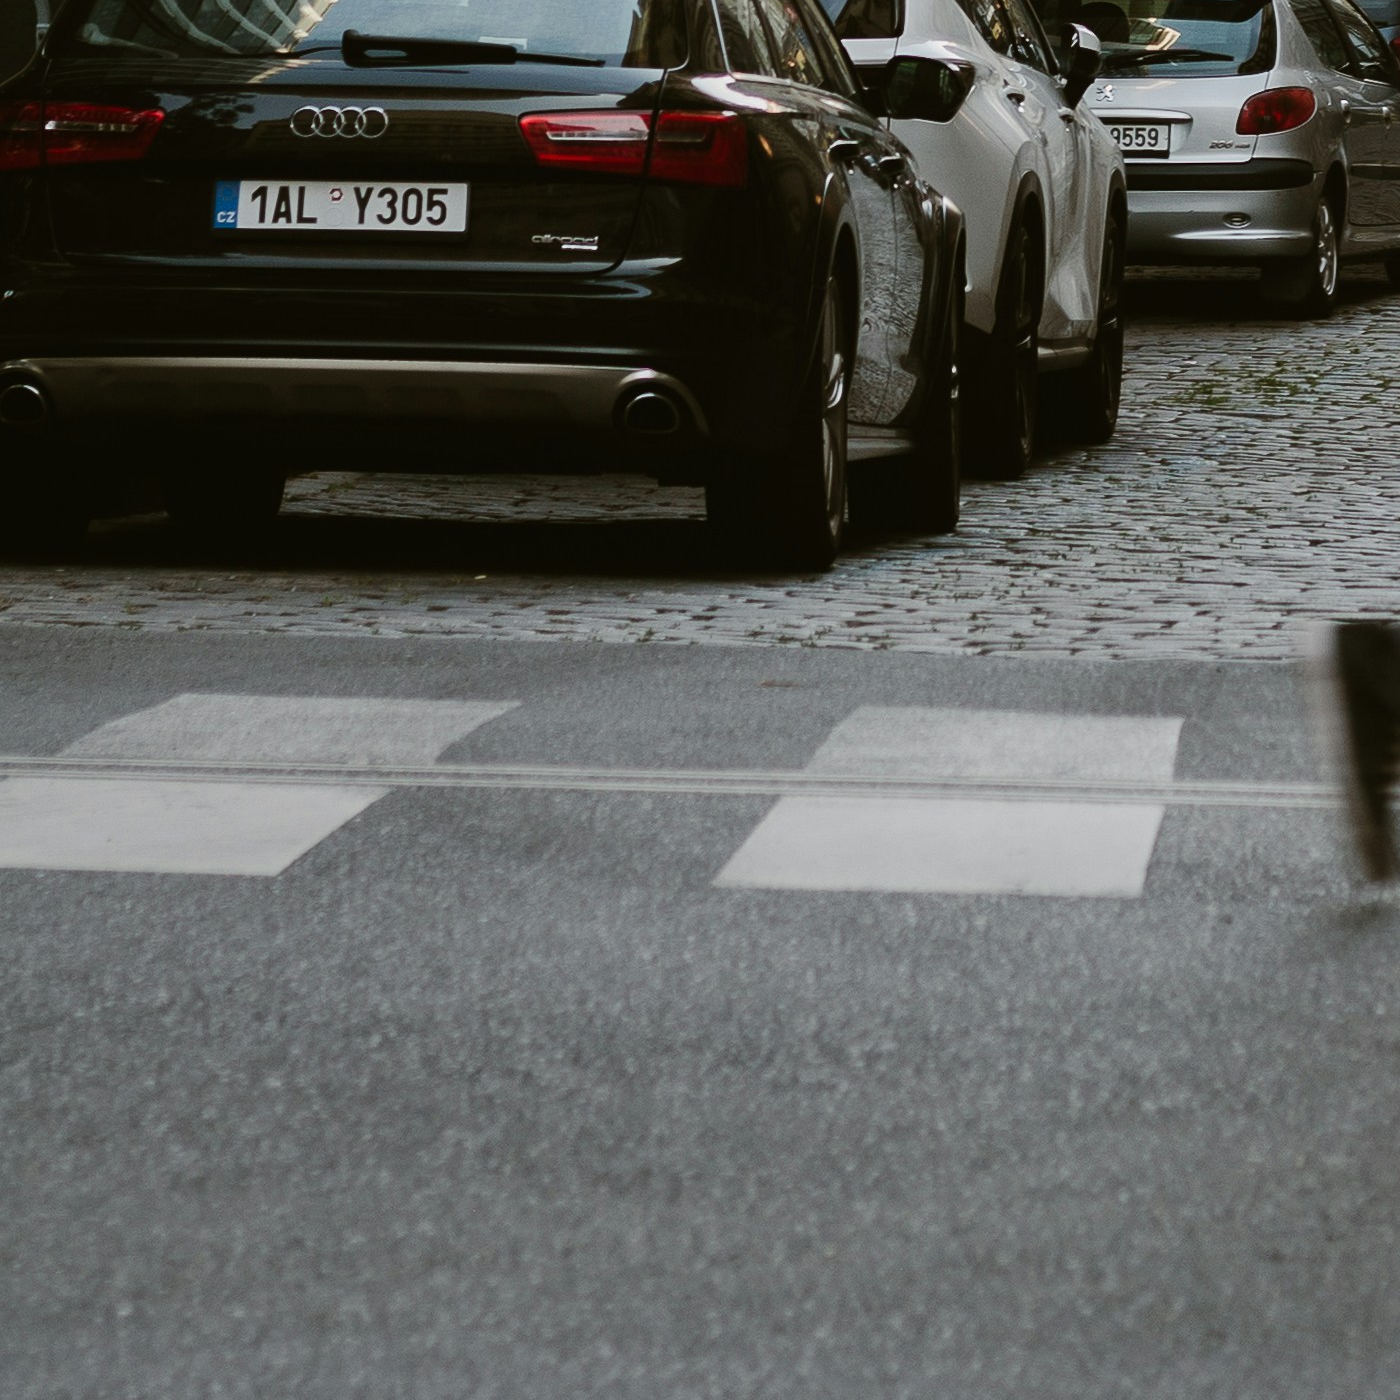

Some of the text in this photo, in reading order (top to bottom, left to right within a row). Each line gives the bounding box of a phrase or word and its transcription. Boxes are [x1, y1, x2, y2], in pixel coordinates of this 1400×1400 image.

[1110, 127, 1159, 147] 9559
[250, 185, 449, 226] 1AL Y305
[216, 211, 235, 223] CZ
[531, 234, 599, 245] allroad
